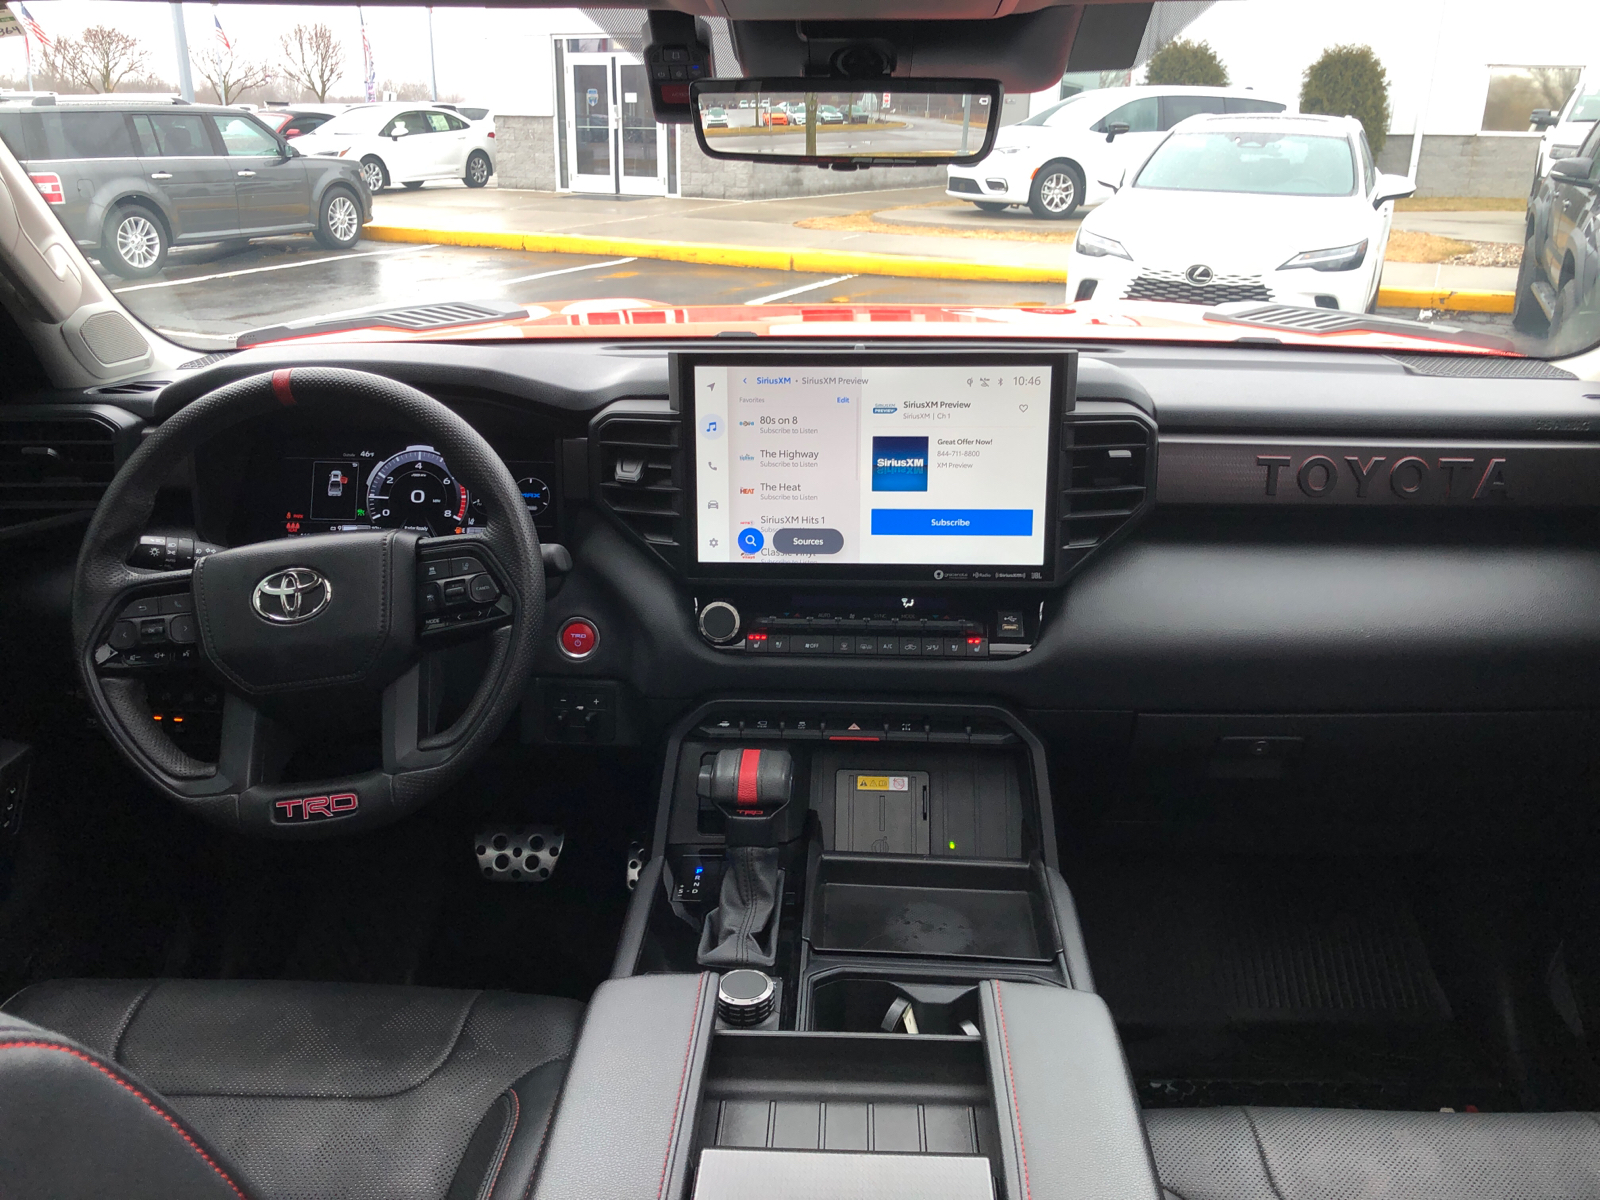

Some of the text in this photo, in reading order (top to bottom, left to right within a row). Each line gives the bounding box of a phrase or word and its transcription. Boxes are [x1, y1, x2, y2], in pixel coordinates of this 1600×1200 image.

[756, 376, 869, 385] SiriusXM SiriusXM Preview
[1013, 376, 1041, 386] 10:46
[903, 401, 971, 409] SiriusXM Preview
[760, 416, 776, 425] 80s
[792, 416, 798, 425] 8
[903, 412, 930, 420] SiriusXM
[936, 412, 947, 420] Ch
[937, 438, 993, 446] Great Offer Now!
[760, 449, 778, 459] The
[779, 450, 819, 460] Highway
[937, 450, 980, 458] 844-711-8800
[877, 458, 924, 468] SiriusXM
[937, 461, 973, 469] XM Preview
[386, 476, 394, 484] 2
[443, 477, 451, 485] 6
[1256, 454, 1513, 500] TOYOTA
[760, 482, 802, 491] The Heat
[410, 489, 425, 503] 0
[382, 508, 391, 517] 0
[443, 509, 452, 518] 8
[760, 515, 800, 525] SiriusXM
[801, 515, 820, 525] Hits
[931, 518, 971, 527] Subscribe
[792, 537, 824, 546] Sources
[276, 793, 359, 820] TRD
